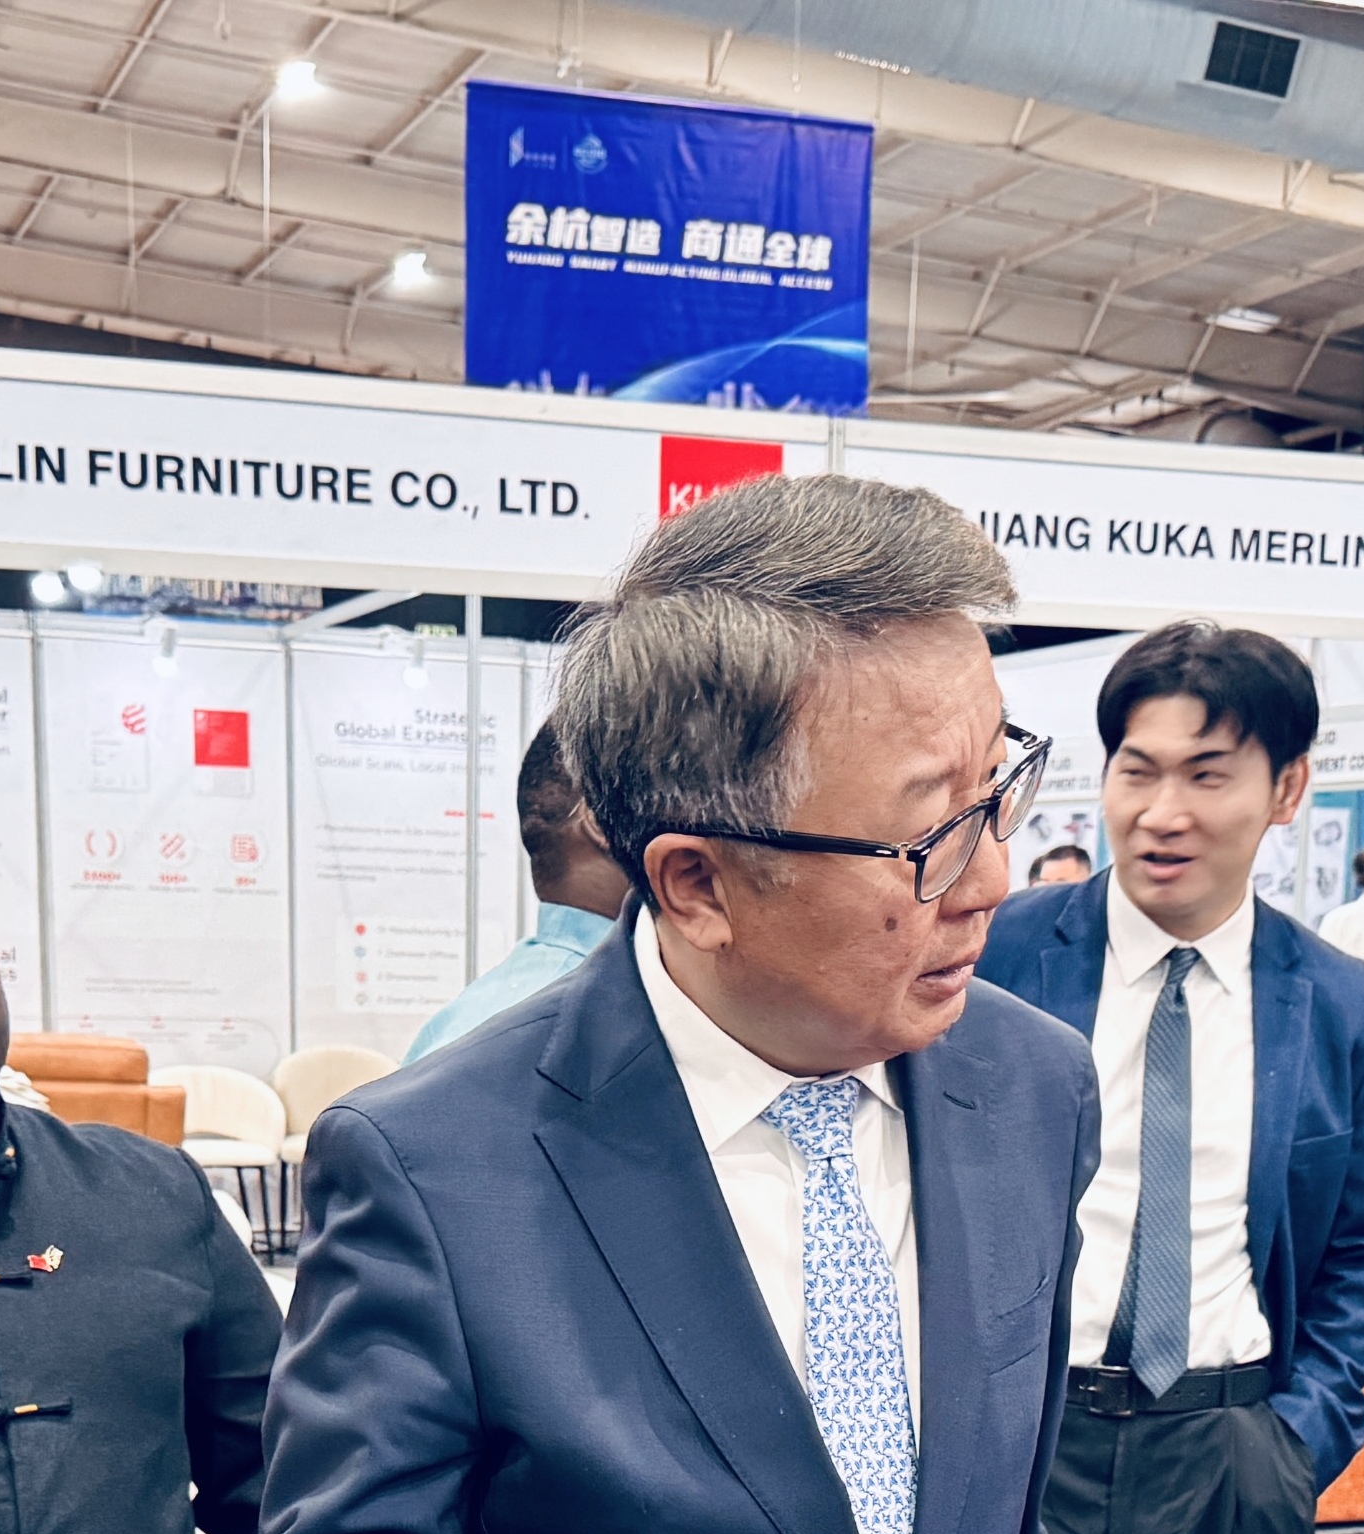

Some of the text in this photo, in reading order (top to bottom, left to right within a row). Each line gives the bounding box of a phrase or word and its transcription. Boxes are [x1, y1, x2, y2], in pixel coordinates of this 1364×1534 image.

[505, 202, 833, 272] 余杭智造 商通全球
[88, 449, 372, 506] FURNITURE
[390, 470, 480, 520] CO.,
[498, 476, 591, 520] LTD.
[1107, 520, 1216, 559] KUKA
[335, 721, 396, 739] Global
[414, 708, 497, 729] Strateic
